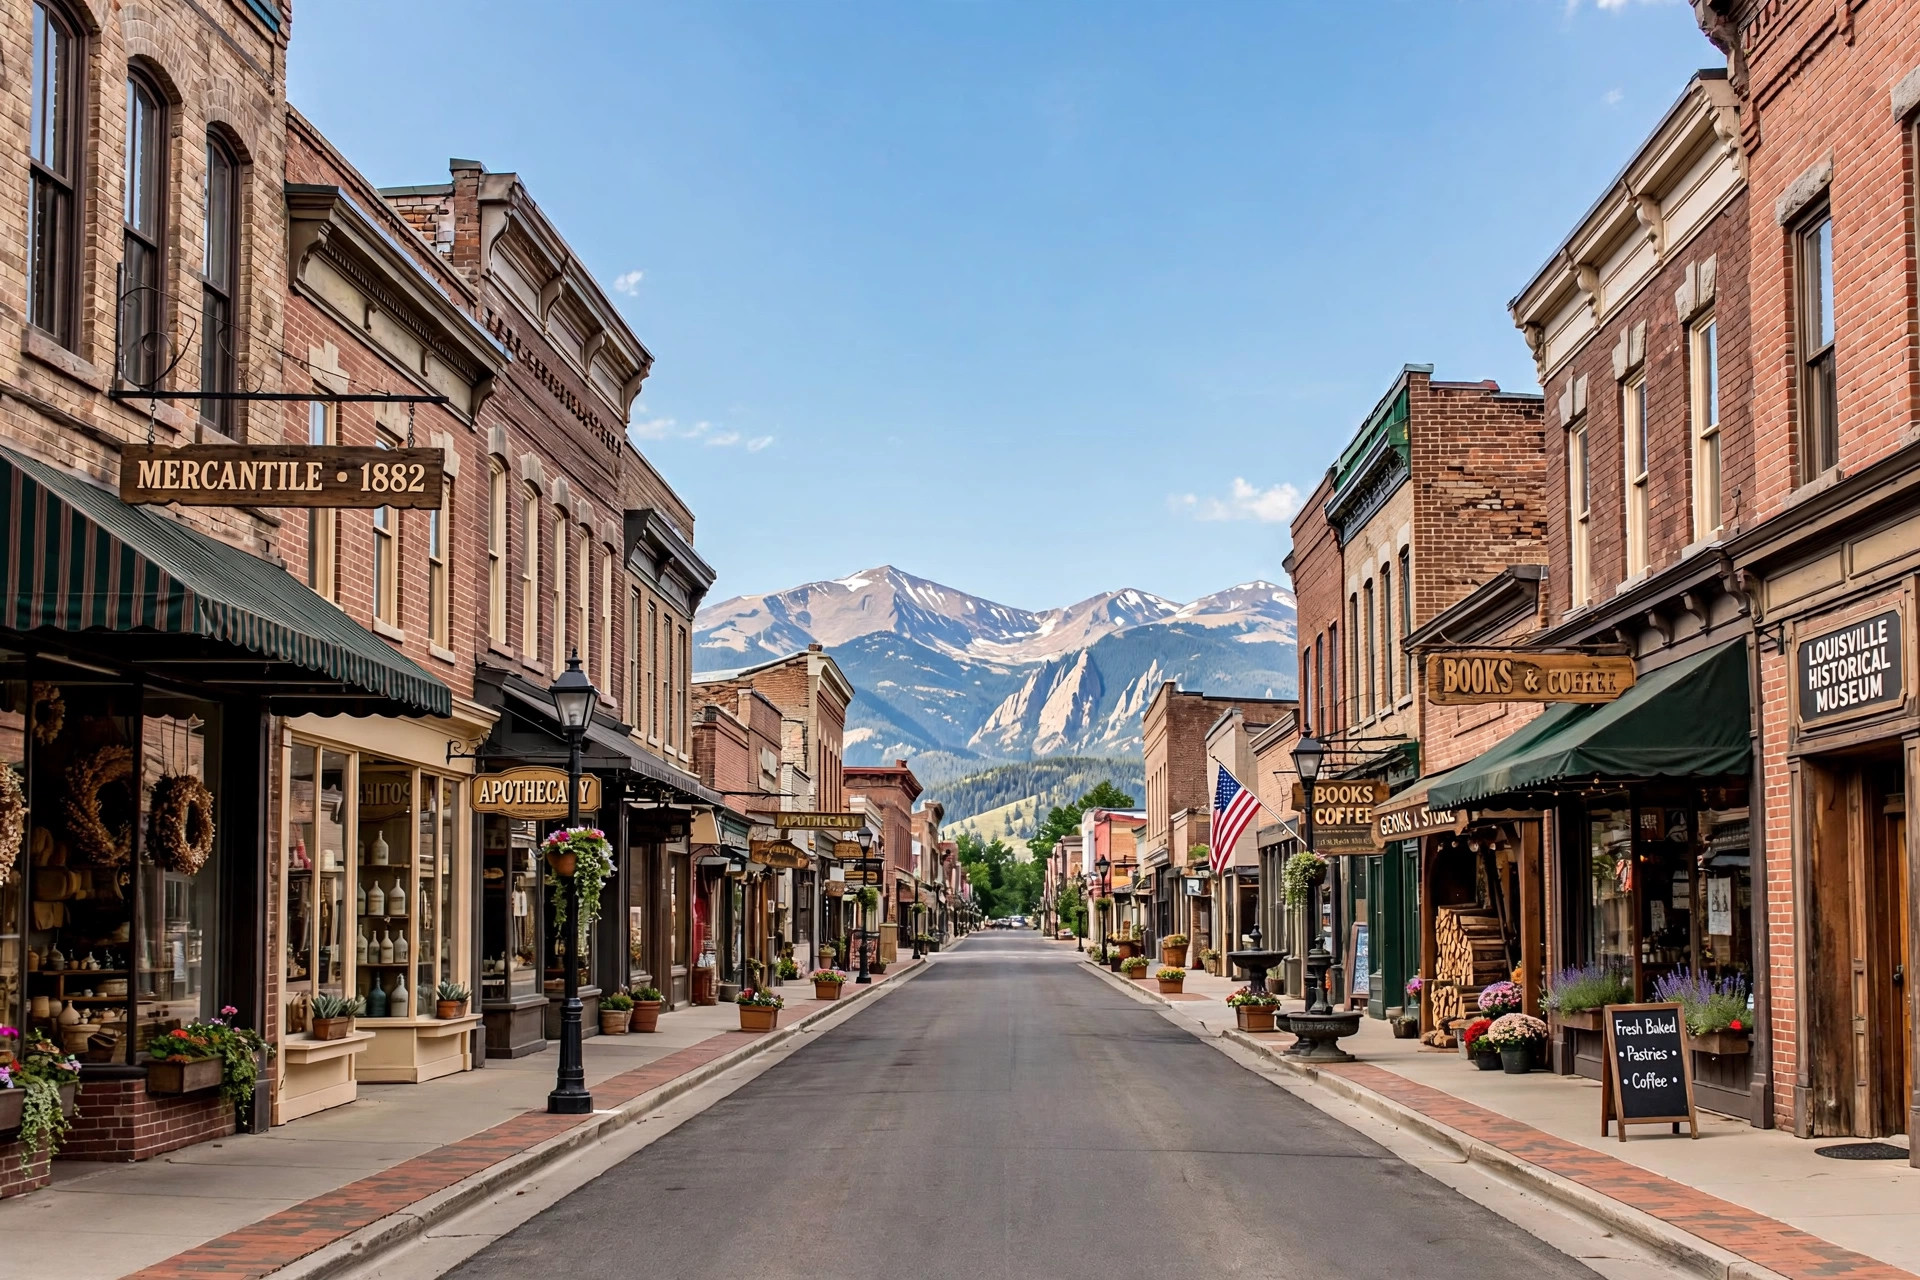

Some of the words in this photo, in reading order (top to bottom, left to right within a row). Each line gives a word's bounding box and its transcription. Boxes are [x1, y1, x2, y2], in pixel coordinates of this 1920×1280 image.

[137, 459, 324, 492] MERCANTILE
[360, 462, 426, 493] 1882
[1808, 619, 1888, 666] LOUISVILLE
[1442, 658, 1514, 694] BOOKS
[1524, 668, 1541, 692] &
[1808, 646, 1891, 690] HISTORICAL
[1816, 673, 1883, 713] MUSEUM
[478, 780, 592, 804] APOTHECAY
[1313, 785, 1374, 804] BOOKS
[1315, 807, 1373, 825] COFFEE
[1615, 1018, 1643, 1036] Fresh
[1645, 1016, 1677, 1035] Baked
[1626, 1045, 1668, 1062] Pastries
[1632, 1072, 1668, 1090] Coffee
